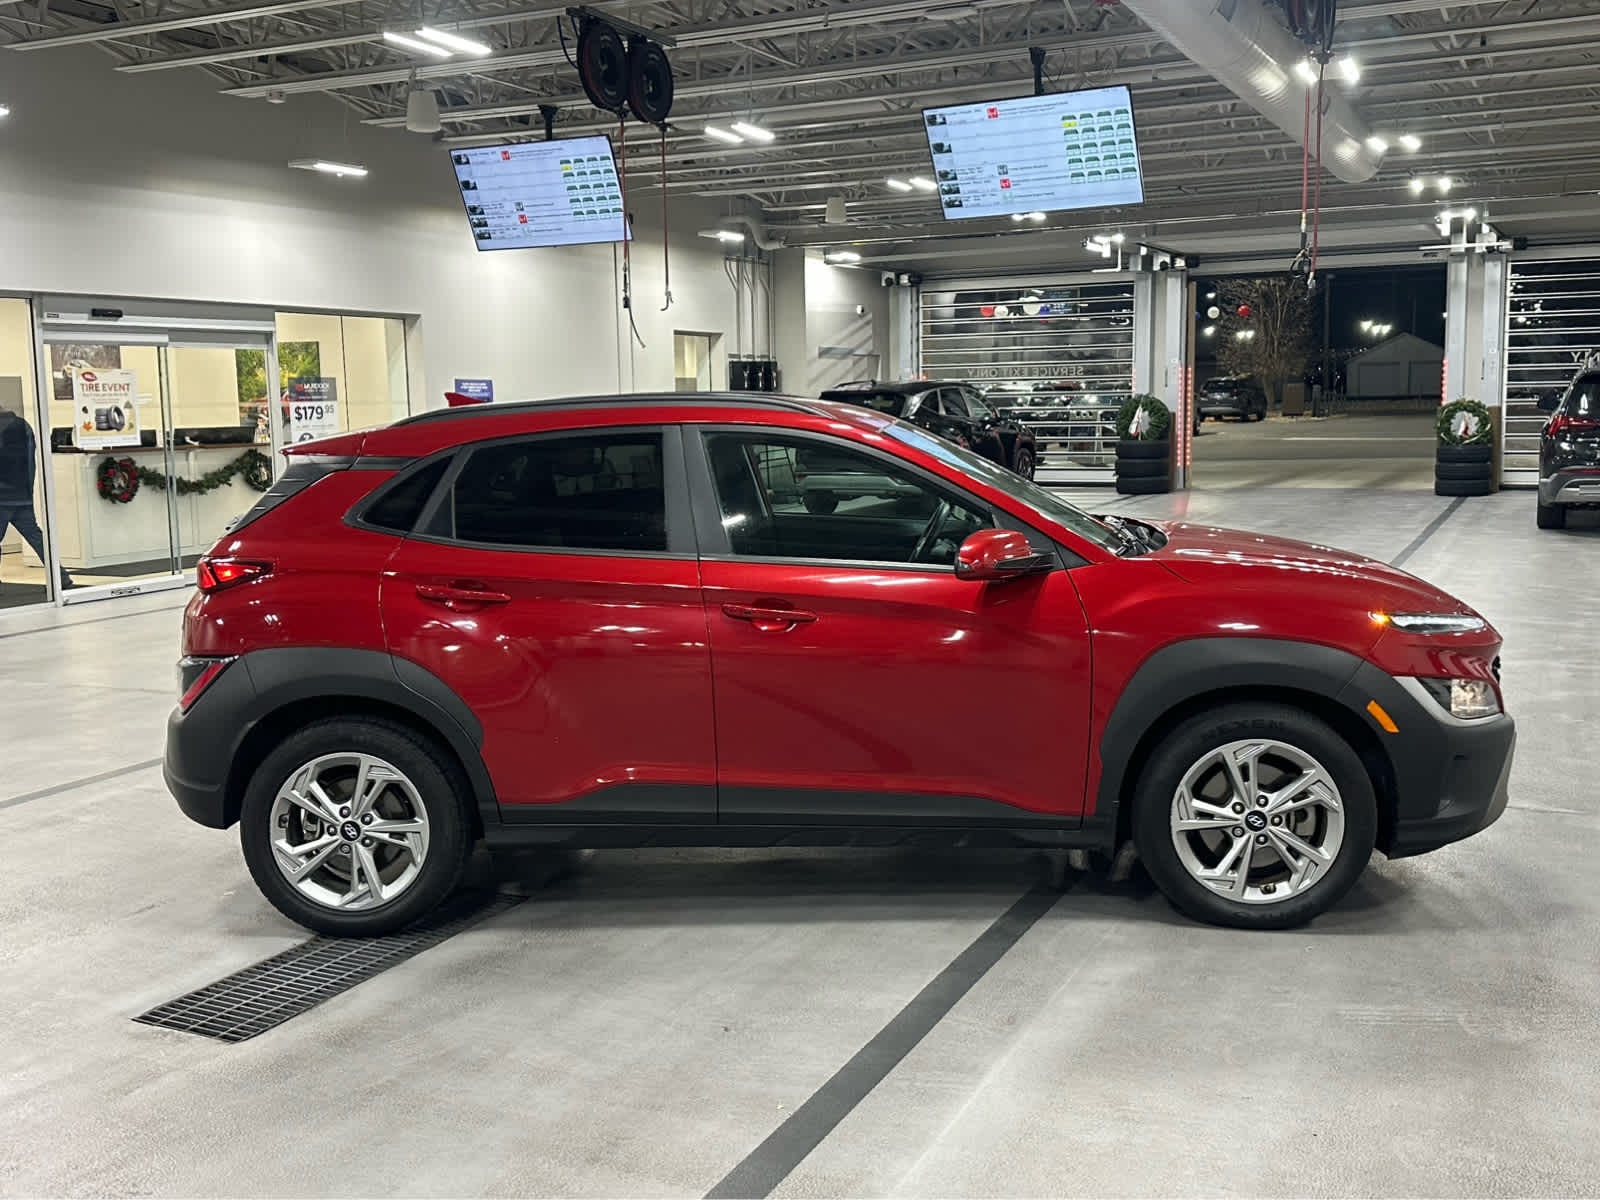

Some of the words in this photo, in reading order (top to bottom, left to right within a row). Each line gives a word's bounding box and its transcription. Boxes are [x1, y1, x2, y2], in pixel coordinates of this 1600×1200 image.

[80, 383, 100, 392] TIRE
[102, 383, 130, 392] EVENT
[294, 406, 323, 421] $179
